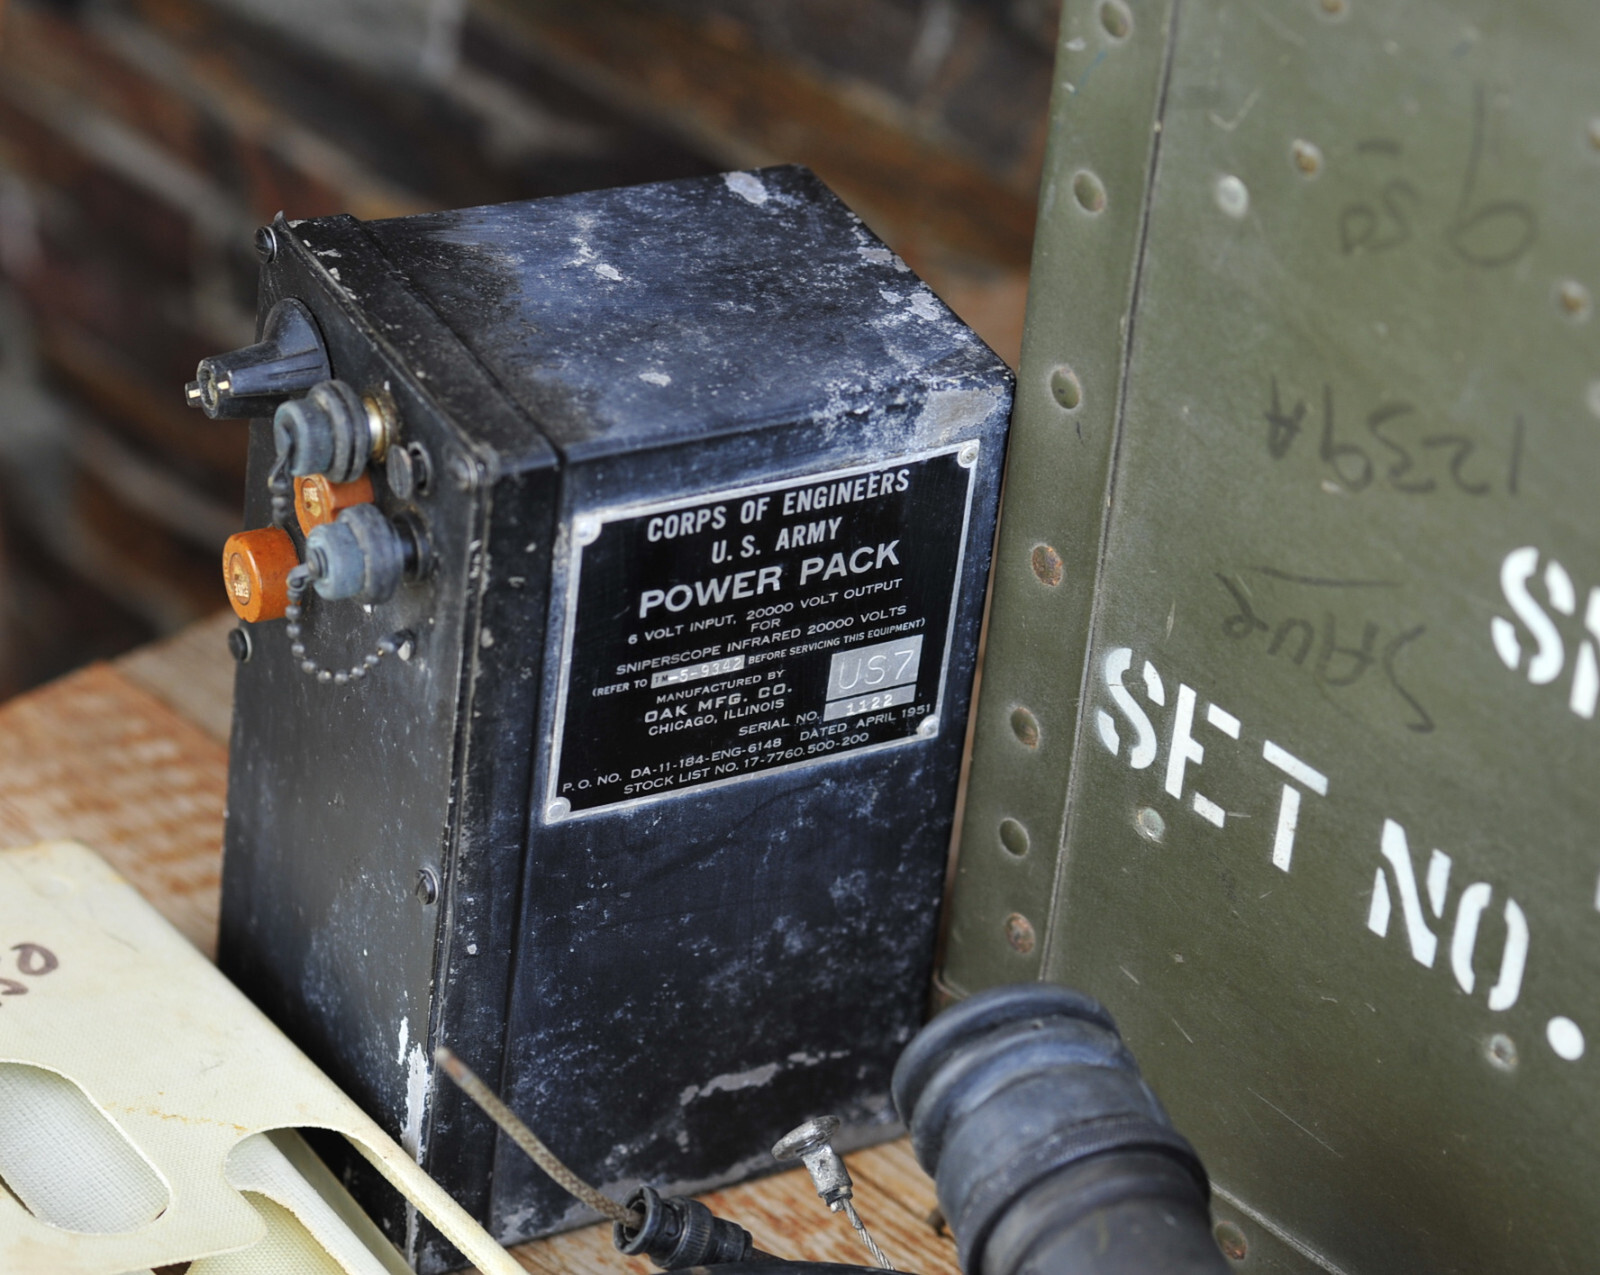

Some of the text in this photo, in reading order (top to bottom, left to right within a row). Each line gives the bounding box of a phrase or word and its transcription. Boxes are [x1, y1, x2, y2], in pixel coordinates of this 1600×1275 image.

[1265, 377, 1525, 495] 1239A
[647, 468, 910, 542] CORPS OF ENGINEERS
[775, 517, 842, 551] ARMY
[628, 578, 902, 645] 6 VOLT INPUT, 20000 VOLT OUTPUT
[639, 539, 900, 619] POWER PACK
[592, 682, 630, 697] (REFER
[634, 679, 648, 690] TO
[748, 649, 788, 665] BEFORE
[789, 638, 840, 656] SERVICING
[843, 632, 865, 644] THIS
[867, 617, 926, 639] EQUIPMENT)
[616, 605, 907, 676] SNIPERSCOPE INFRARED 20000 VOLTS
[750, 618, 782, 633] FOR
[644, 683, 793, 723] OAK MFG. CO.
[648, 699, 785, 736] CHICAGO, ILLINOIS
[656, 669, 786, 704] MANUFACTURED BY
[738, 694, 893, 736] SERIAL NO. 1122
[597, 773, 622, 786] NO.
[630, 738, 782, 779] DA-11-184-ENG-6148
[800, 723, 848, 741] DATED
[856, 712, 897, 729] APRIL
[901, 703, 931, 718] 1951
[623, 775, 674, 795] STOCK
[679, 767, 711, 783] LIST
[714, 761, 739, 775] NO.
[1099, 648, 1585, 1061] SET NO.
